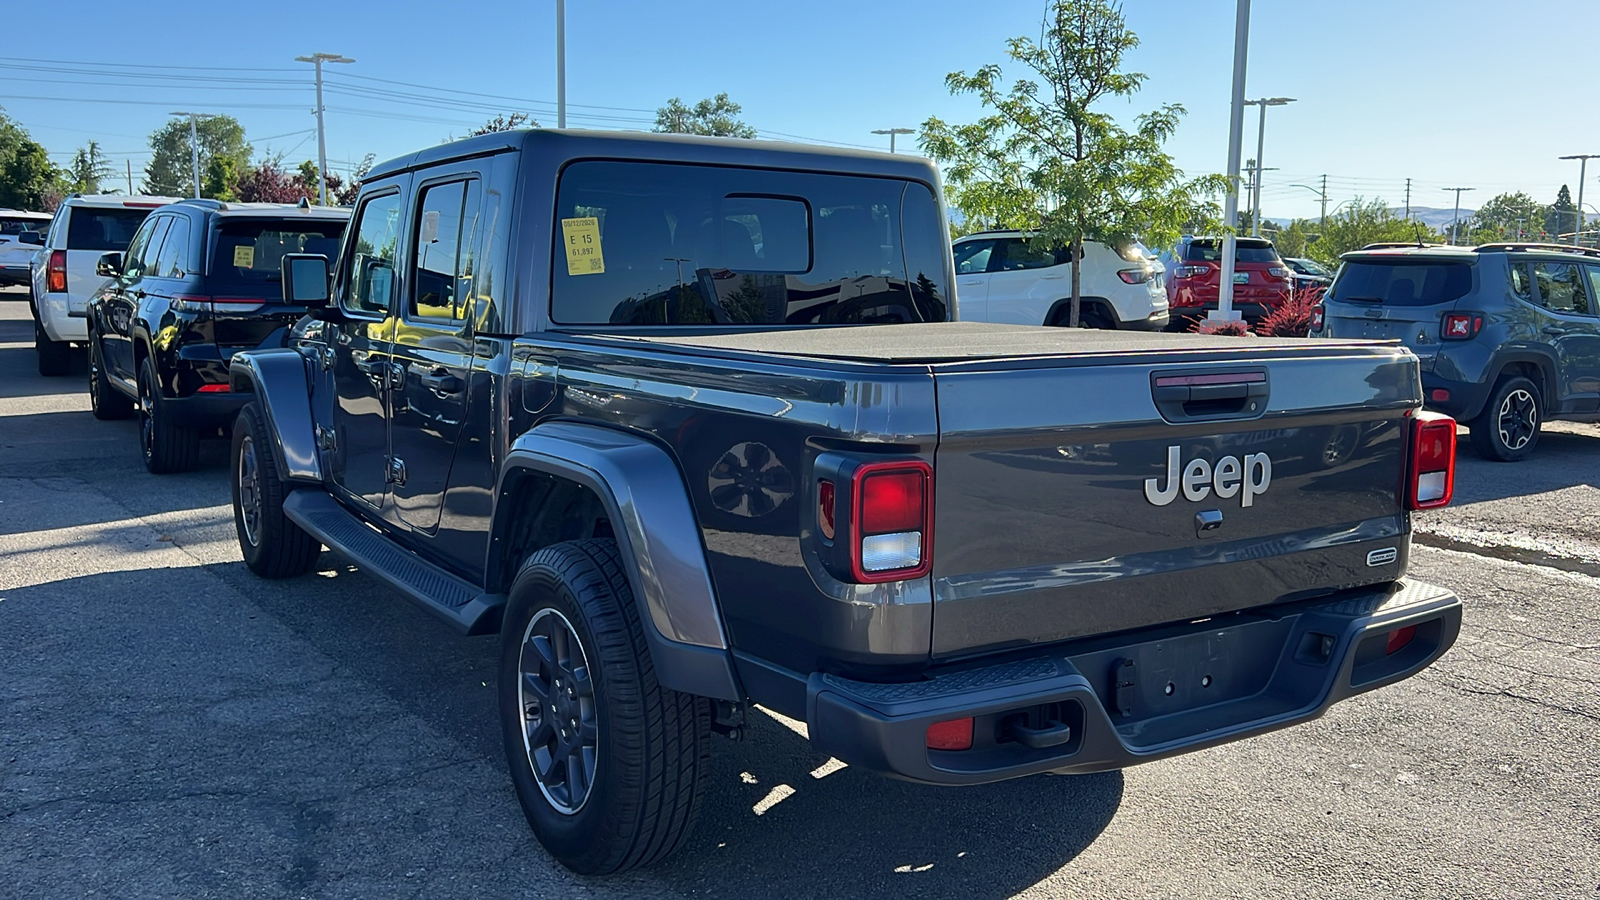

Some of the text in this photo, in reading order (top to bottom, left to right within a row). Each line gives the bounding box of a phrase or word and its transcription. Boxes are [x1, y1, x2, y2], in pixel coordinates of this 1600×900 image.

[570, 234, 592, 244] E 15
[572, 248, 593, 256] 61,897
[1144, 446, 1272, 507] Jeep
